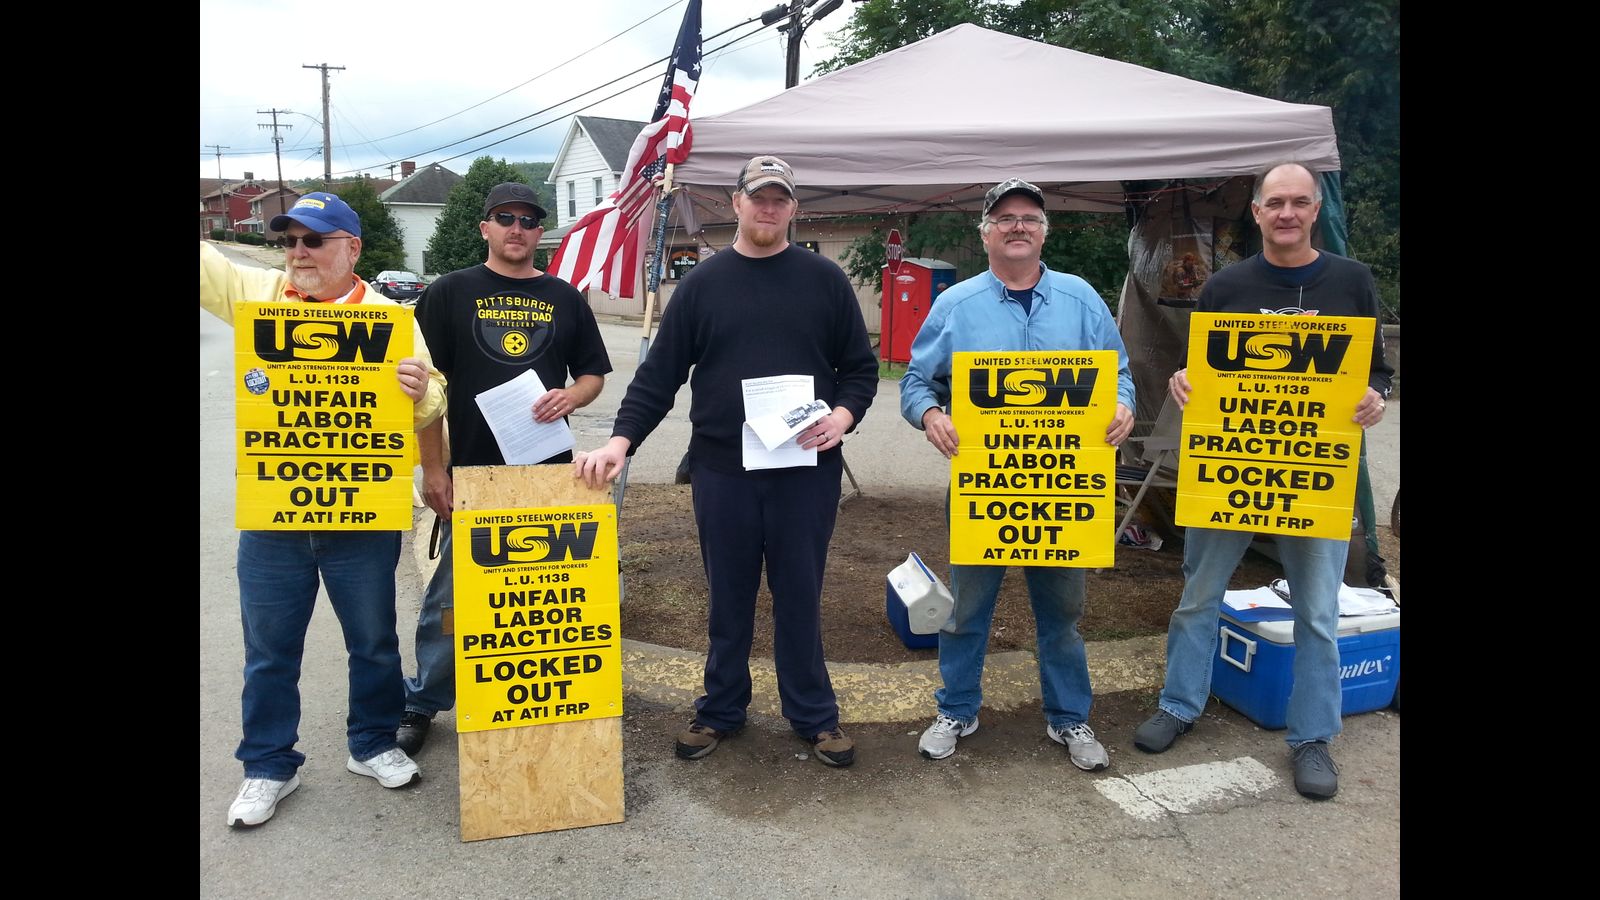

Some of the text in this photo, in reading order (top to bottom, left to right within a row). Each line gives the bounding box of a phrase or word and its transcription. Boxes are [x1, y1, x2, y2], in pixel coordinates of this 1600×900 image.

[888, 243, 902, 260] STOP
[259, 308, 388, 320] UNITED STEELWORKERS
[476, 296, 555, 313] PITTSBURGH
[477, 309, 552, 322] GREATEST DAD
[1214, 320, 1255, 328] UNITED
[253, 319, 394, 363] USW
[974, 357, 1093, 366] UNITED STEELWORKERS
[1206, 330, 1353, 375] USW
[325, 374, 360, 385] 1138
[969, 368, 1099, 409] USW
[272, 390, 377, 408] UNFAIR
[1274, 384, 1310, 395] 1138
[1219, 397, 1326, 418] UNFAIR
[278, 411, 372, 429] LABOR
[1033, 419, 1065, 428] 1138
[1222, 417, 1318, 438] LABOR
[245, 431, 404, 450] PRACTICES
[984, 434, 1081, 450] UNFAIR
[1189, 434, 1350, 460] PRACTICES
[988, 453, 1076, 470] LABOR
[257, 461, 393, 482] LOCKED
[958, 472, 1106, 490] PRACTICES
[1198, 463, 1335, 491] LOCKED
[290, 486, 359, 507] OUT
[1228, 489, 1298, 512] OUT
[272, 511, 377, 523] AT ATI FRP
[475, 512, 593, 525] UNITED STEELWORKERS
[969, 501, 1095, 521] LOCKED
[1210, 511, 1314, 530] AT ATI FRP
[998, 525, 1063, 545] OUT
[470, 521, 599, 569] USW
[983, 548, 1080, 561] AT ATI FRP
[538, 573, 570, 583] 1138
[489, 587, 586, 609] UNFAIR
[494, 607, 582, 629] LABOR
[463, 624, 612, 651] PRACTICES
[475, 654, 602, 683] LOCKED
[507, 680, 572, 705] OUT
[492, 702, 590, 723] AT ATI FRP
